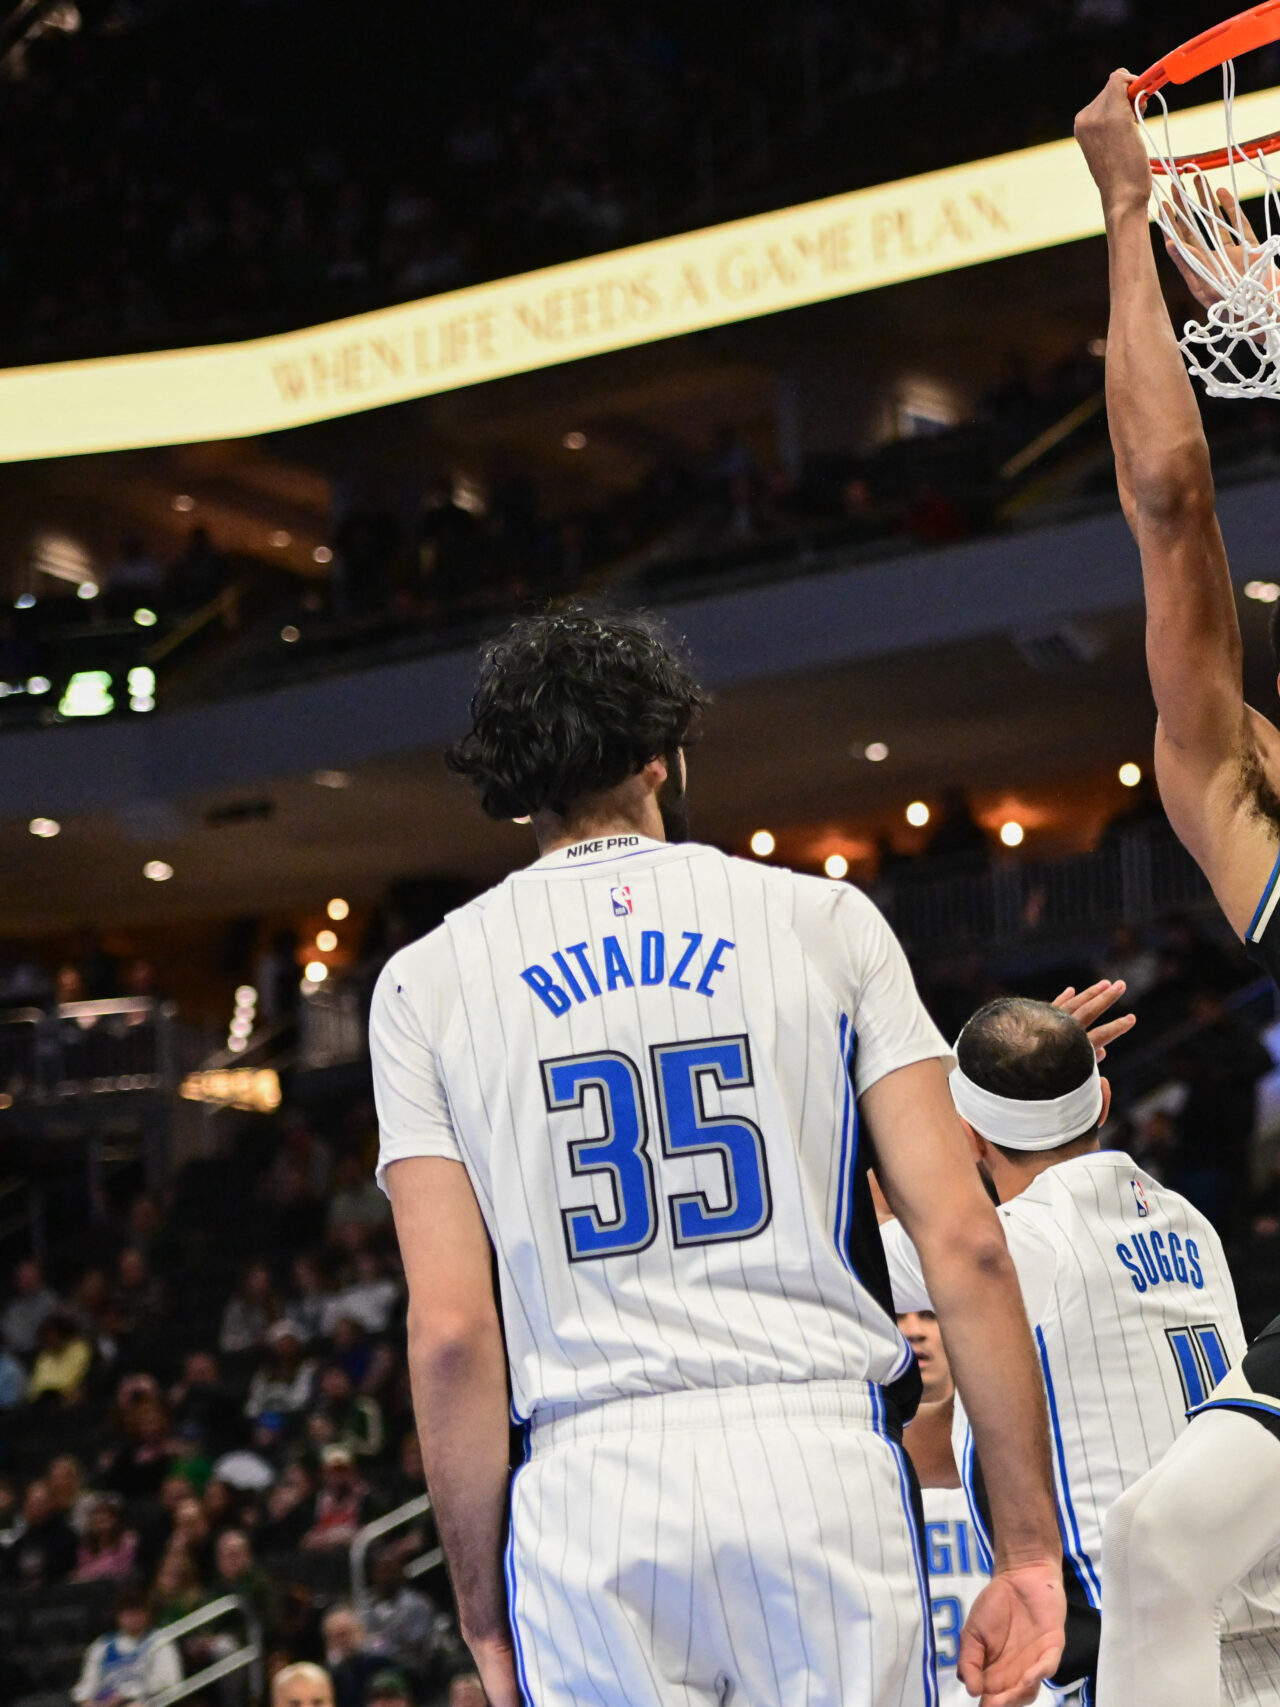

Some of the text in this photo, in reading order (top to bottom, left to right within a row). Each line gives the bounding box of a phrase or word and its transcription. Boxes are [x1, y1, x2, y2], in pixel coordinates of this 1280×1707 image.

[271, 187, 1012, 402] WHEN LIFE NEEDS A GAME PLAN
[567, 836, 639, 859] NIKE PRO
[519, 930, 736, 1018] BITADZE
[538, 1033, 773, 1264] 35
[1116, 1230, 1204, 1293] SUGGS
